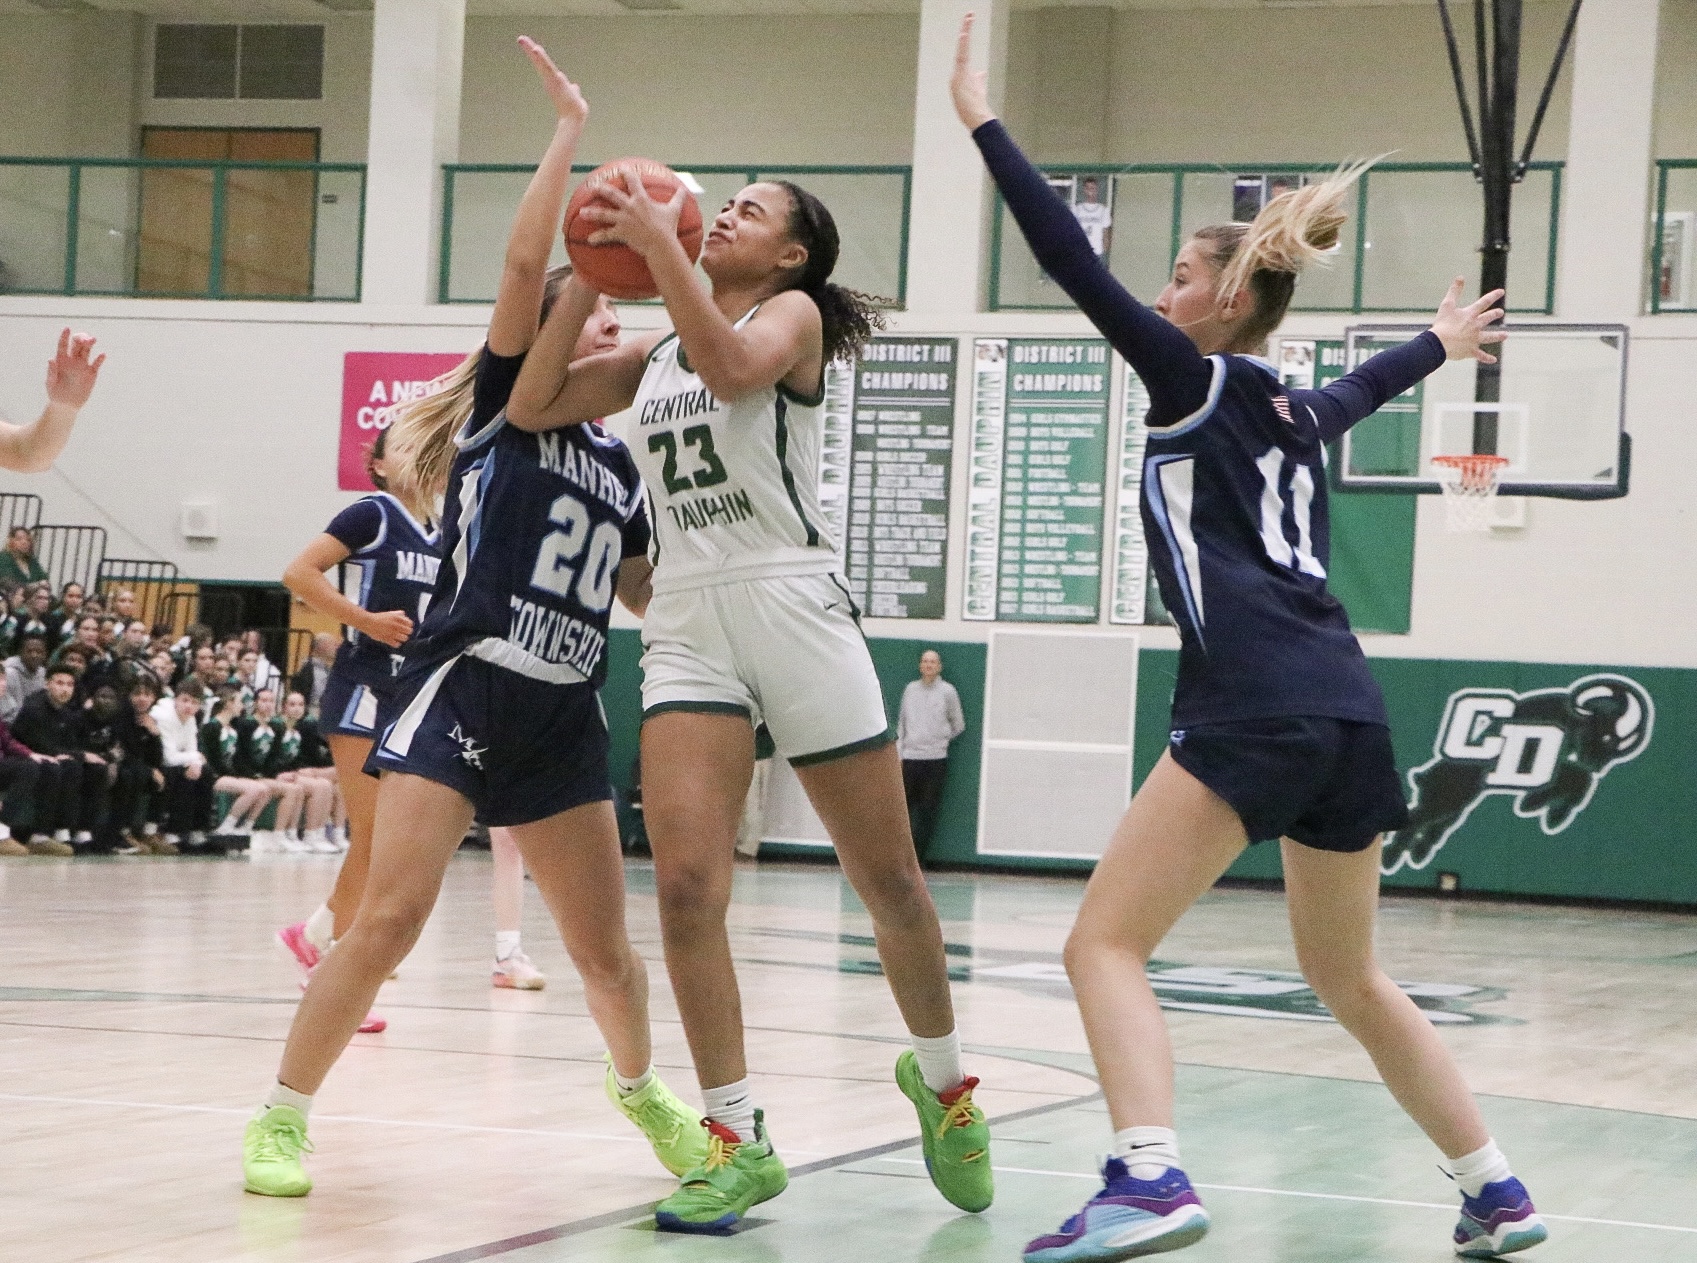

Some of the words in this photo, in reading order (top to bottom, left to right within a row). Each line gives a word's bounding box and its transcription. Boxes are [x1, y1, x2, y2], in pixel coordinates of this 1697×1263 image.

[862, 343, 930, 362] DISTRICT
[933, 345, 951, 362] III
[862, 371, 949, 390] CHAMPIONS
[1013, 345, 1084, 363] DISTRICT
[1087, 346, 1106, 363] III
[368, 380, 388, 402] A
[640, 386, 720, 425] CENTRAL
[1013, 374, 1103, 392] CHAMPIONS
[973, 371, 1002, 489] DAUPHIN
[647, 423, 728, 496] 23
[1255, 446, 1327, 579] 11
[529, 493, 622, 614] 20
[967, 497, 999, 617] CENTRAL
[1443, 697, 1565, 787] CD
